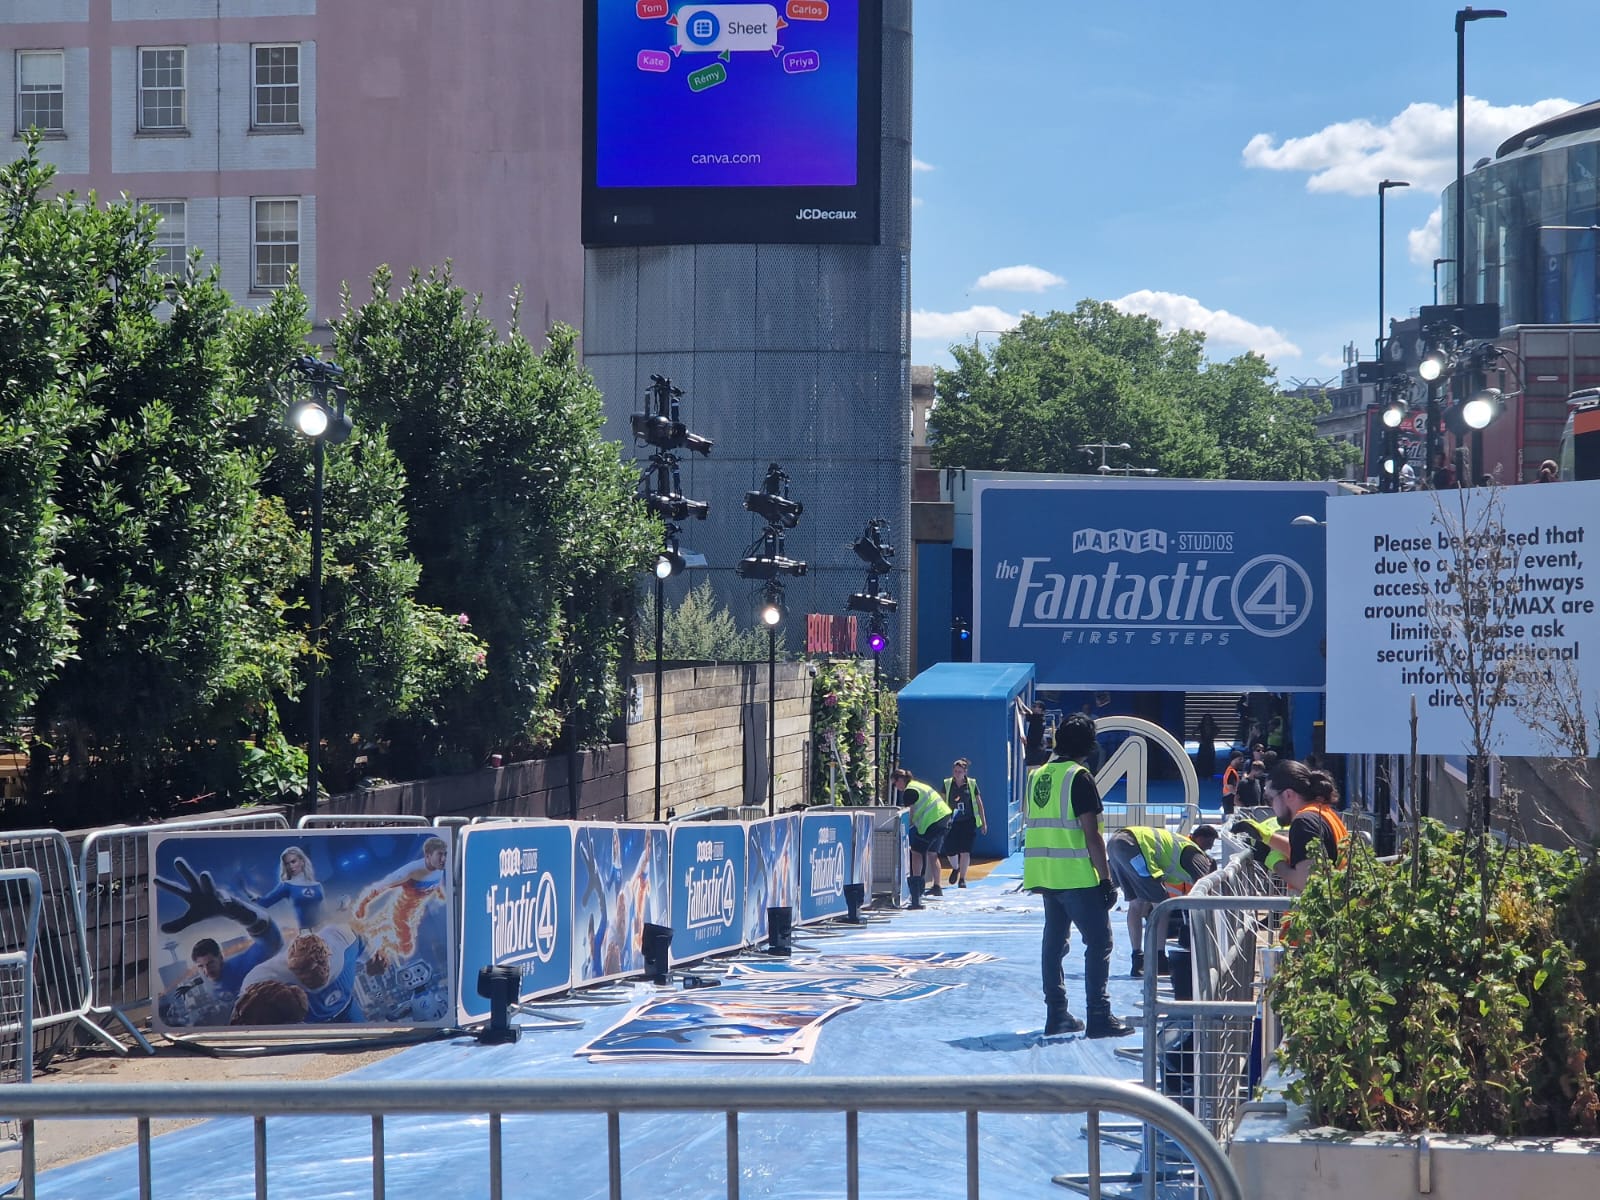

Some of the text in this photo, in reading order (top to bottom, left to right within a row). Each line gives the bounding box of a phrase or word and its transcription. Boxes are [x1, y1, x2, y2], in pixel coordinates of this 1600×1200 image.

[642, 4, 662, 13] Tom
[792, 5, 823, 15] Carlos
[728, 22, 768, 34] Sheet
[643, 56, 664, 66] Kate
[789, 57, 813, 68] Priya
[691, 152, 761, 164] canva.com
[795, 209, 857, 220] JCDecaux
[1074, 530, 1233, 552] MARVEL STUDIOS
[1374, 534, 1432, 552] Please
[1438, 532, 1460, 550] be
[1545, 526, 1584, 544] that
[1375, 557, 1407, 574] due
[1414, 558, 1431, 573] to
[1437, 560, 1448, 572] a
[1524, 550, 1583, 570] event,
[995, 557, 1299, 628] the Fantastic 4
[1374, 580, 1429, 596] access
[1434, 579, 1451, 594] to
[1364, 598, 1427, 619] around
[1562, 599, 1594, 615] are
[807, 613, 857, 653] BOULR
[1531, 619, 1564, 638] ask
[1062, 631, 1230, 646] FIRST STEPS
[491, 878, 554, 965] Fantastic 4
